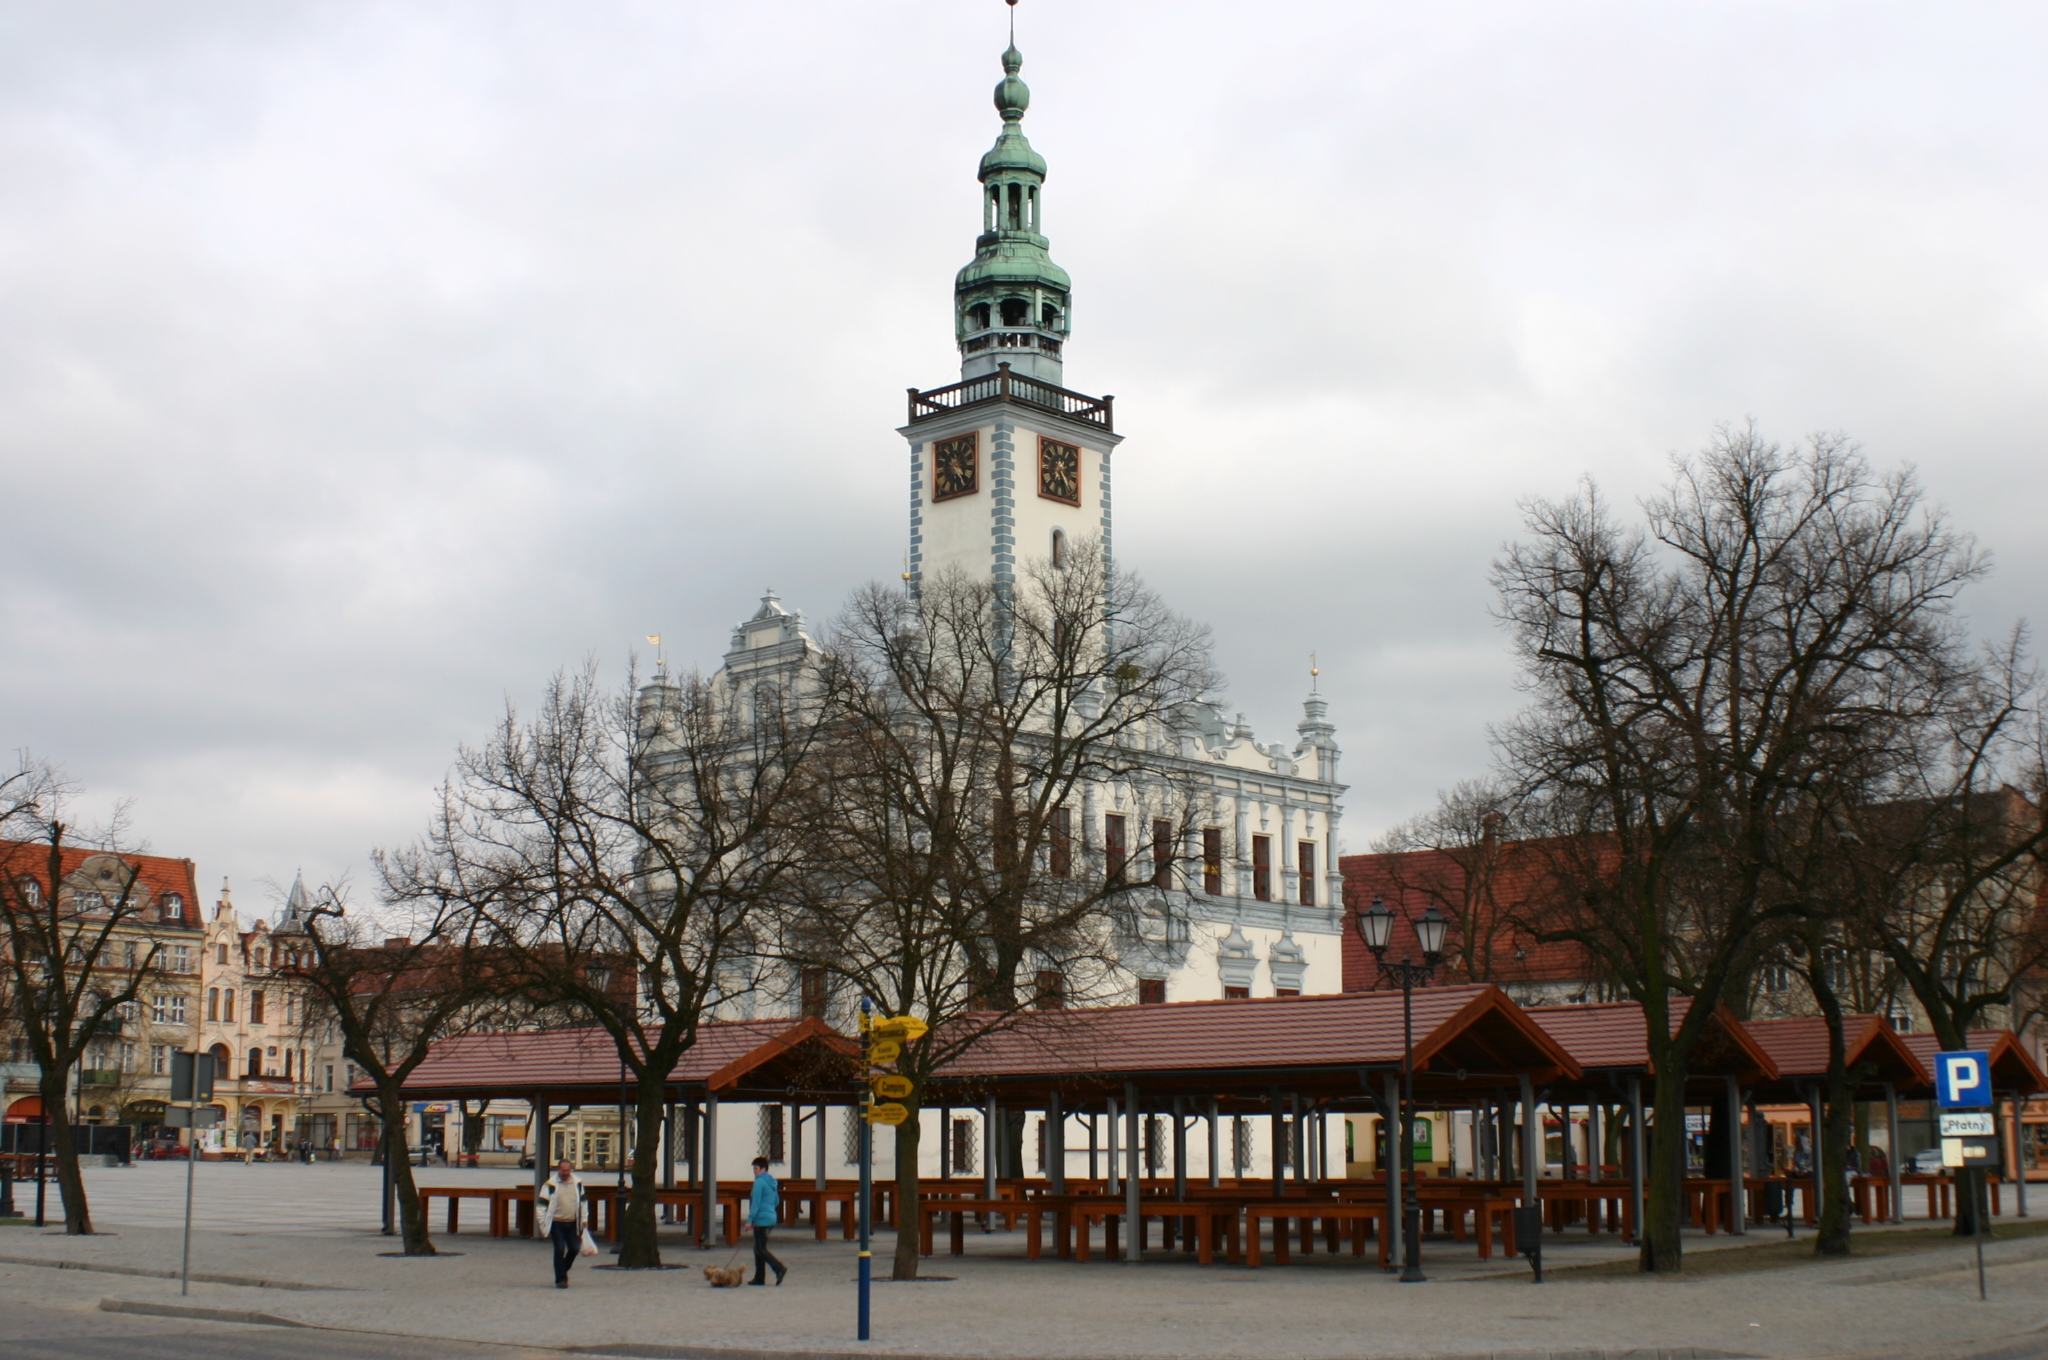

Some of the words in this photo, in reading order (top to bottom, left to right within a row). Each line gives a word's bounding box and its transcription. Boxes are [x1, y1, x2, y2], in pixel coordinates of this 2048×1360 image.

[1947, 1057, 1979, 1102] P
[882, 1081, 906, 1095] Camping
[1948, 1119, 1985, 1131] Płatny
